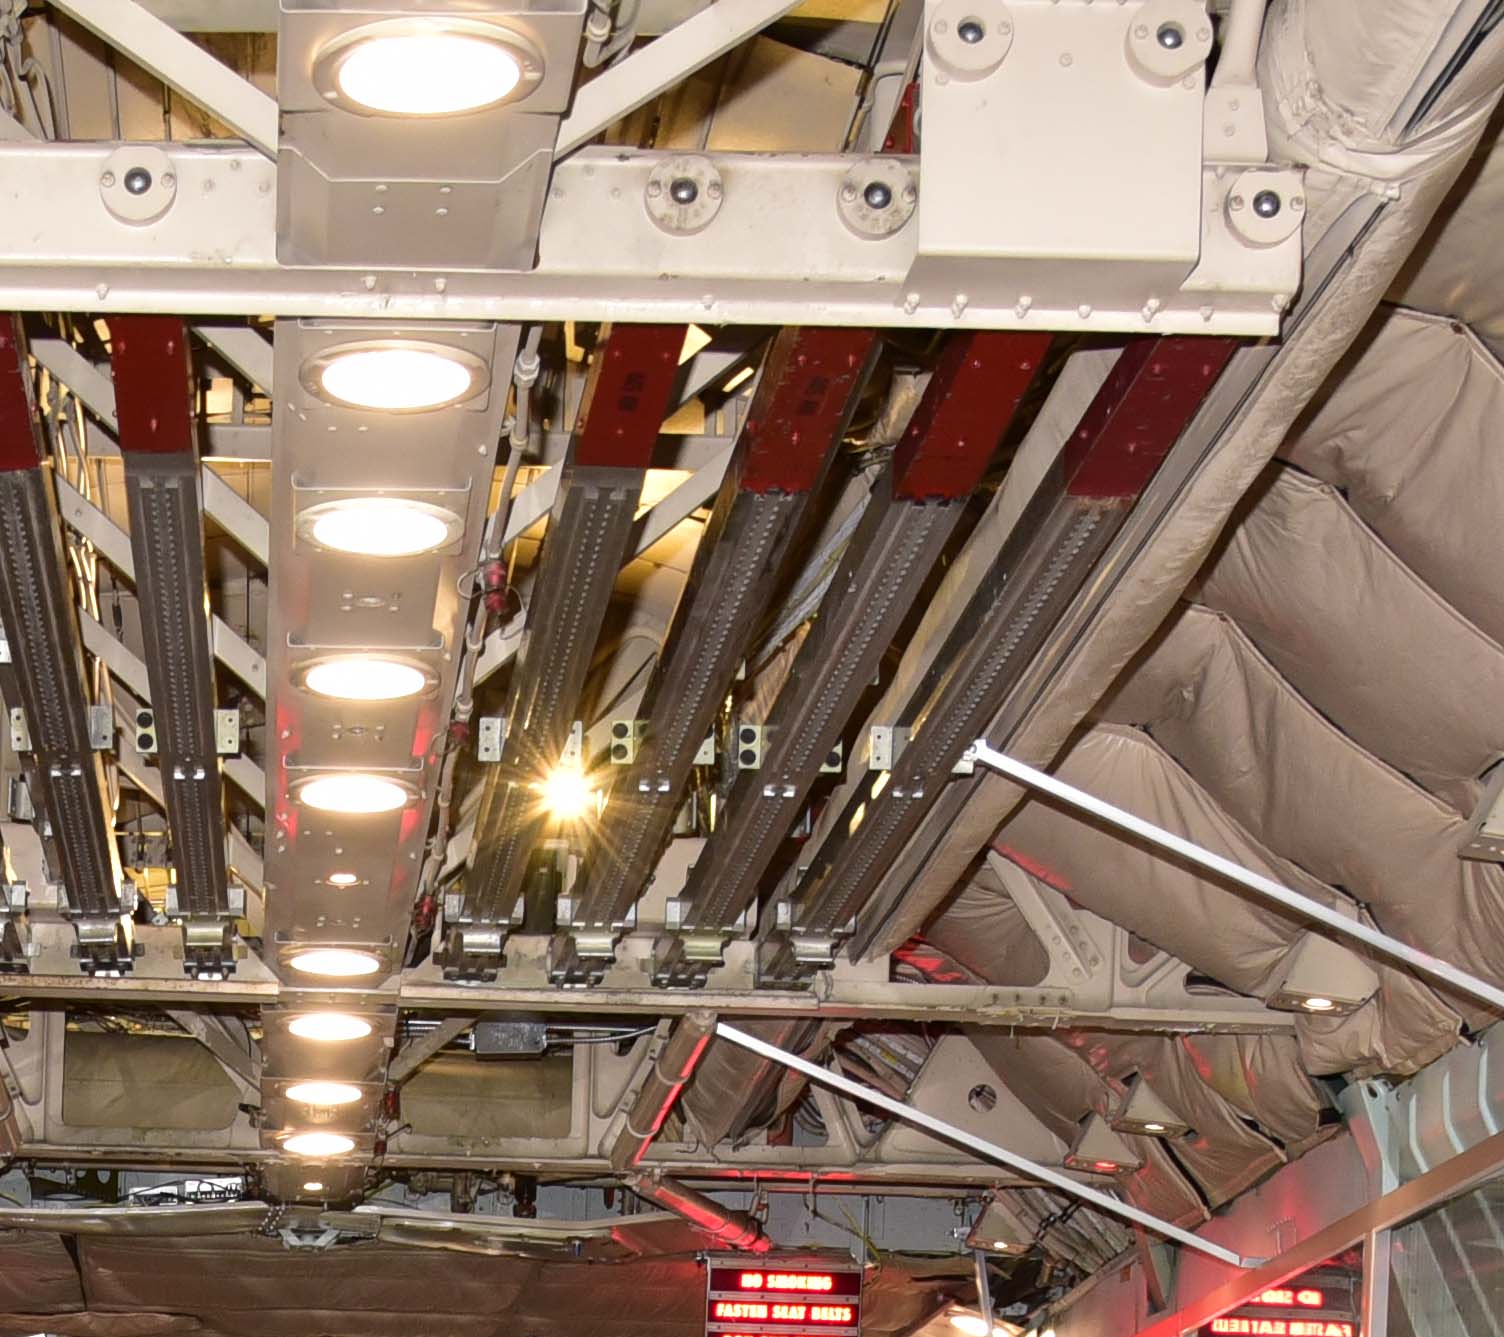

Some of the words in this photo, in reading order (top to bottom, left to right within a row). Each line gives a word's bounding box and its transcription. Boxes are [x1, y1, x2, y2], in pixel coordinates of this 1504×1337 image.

[740, 1273, 763, 1288] NO
[766, 1274, 833, 1290] SMOKING
[715, 1302, 768, 1319] FASTEN
[771, 1304, 807, 1320] SEAT
[810, 1306, 852, 1322] BELTS
